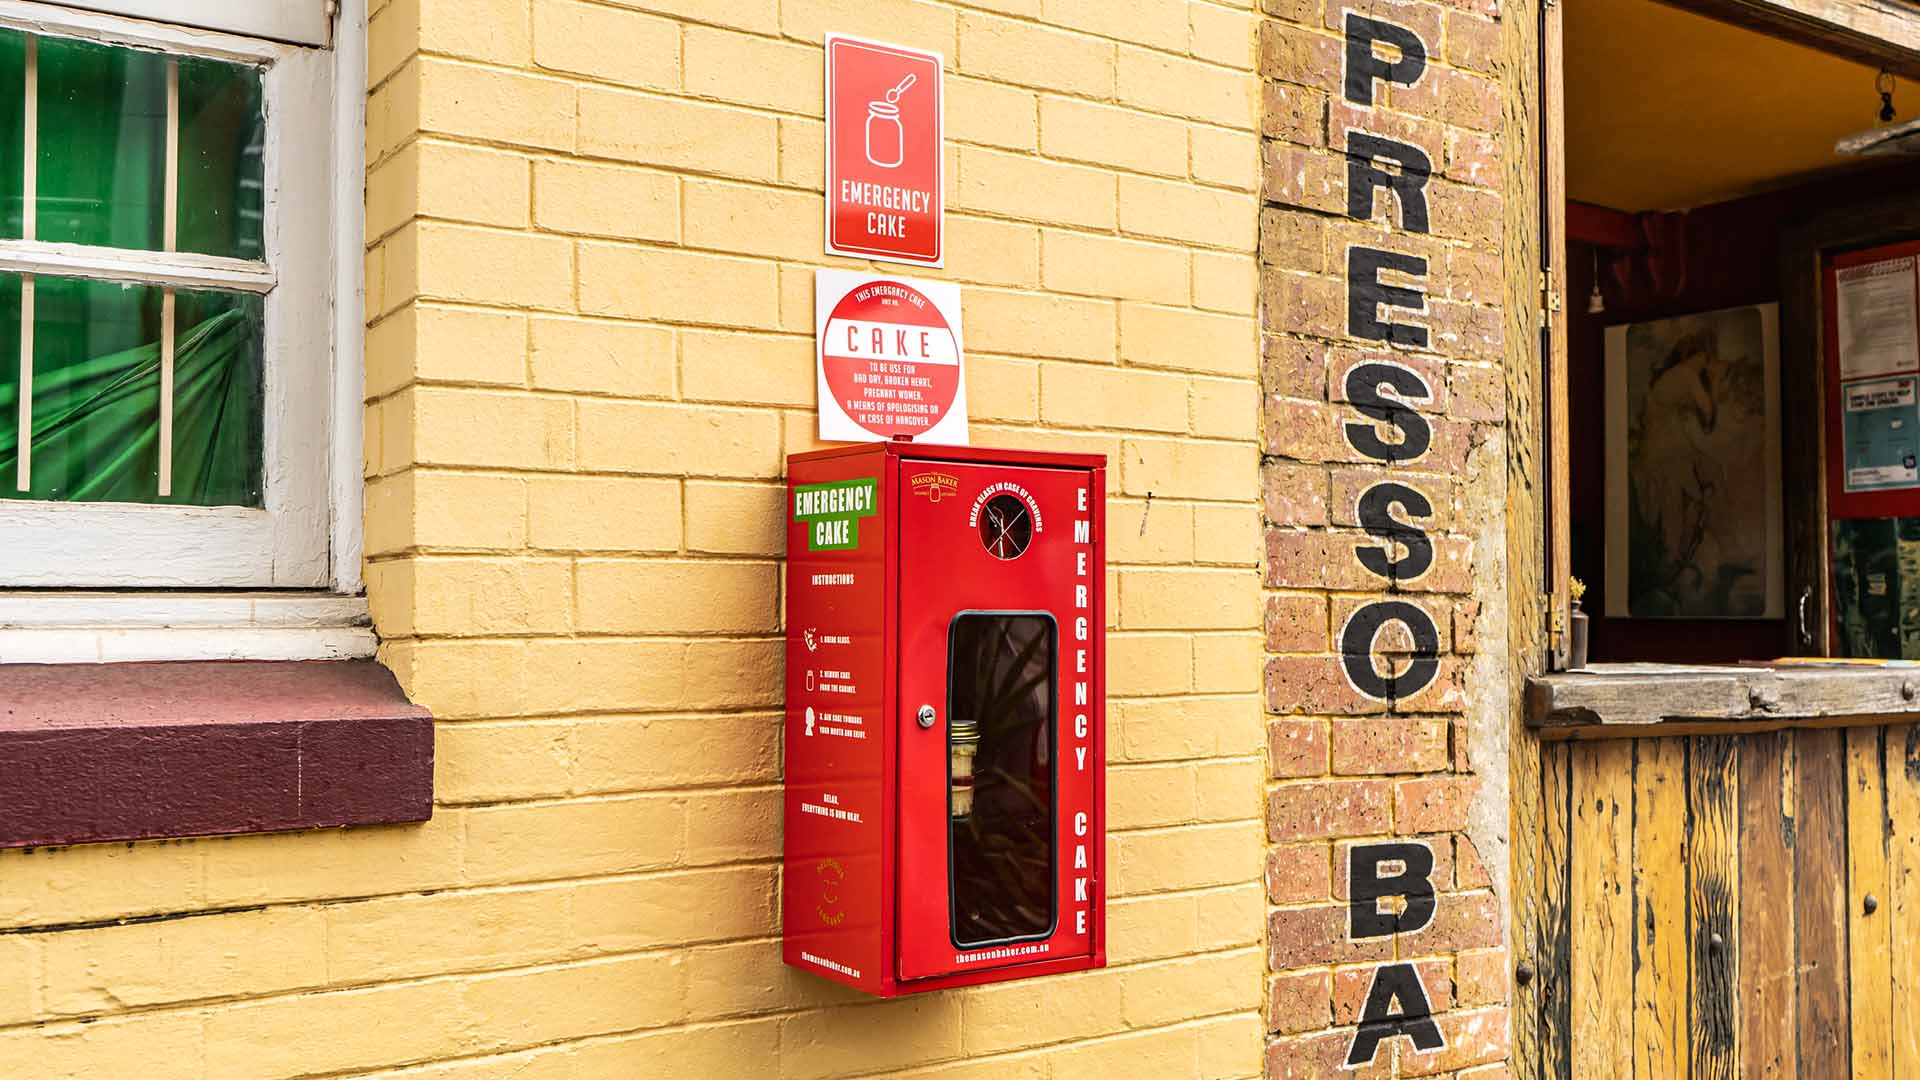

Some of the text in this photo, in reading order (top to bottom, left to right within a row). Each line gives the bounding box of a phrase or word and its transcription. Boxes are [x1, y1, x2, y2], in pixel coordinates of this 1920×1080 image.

[841, 180, 930, 213] EMERGENCY
[867, 212, 906, 238] CAKE
[855, 290, 871, 303] THIS
[909, 293, 926, 308] CAKE
[847, 326, 930, 358] CAKE
[1340, 11, 1440, 701] PRESSO
[853, 373, 867, 385] BAD
[884, 375, 909, 387] BROKEN
[869, 362, 916, 375] TO BE USE FOR
[863, 388, 897, 400] PREGNANT
[847, 400, 939, 415] A MEANS OF APOLOGISING OR
[859, 414, 866, 424] IN
[867, 414, 884, 425] CASE
[885, 415, 893, 425] OF
[911, 475, 959, 488] MASON BAKER
[796, 485, 873, 516] EMERGENCY
[968, 482, 1043, 533] BREAK GLASS IN CASE OF CRAVINGS
[816, 520, 849, 546] CAKE
[811, 573, 855, 586] INSTRUCTIONS
[1074, 488, 1090, 934] EMERGENCY CAKE
[802, 803, 829, 817] EVERYTHING
[829, 807, 835, 818] IS
[835, 809, 847, 820] NOW
[801, 951, 861, 979] themasonbaker.com.au
[956, 944, 1050, 964] themasonbaker.com.au
[1346, 840, 1446, 1070] BA
